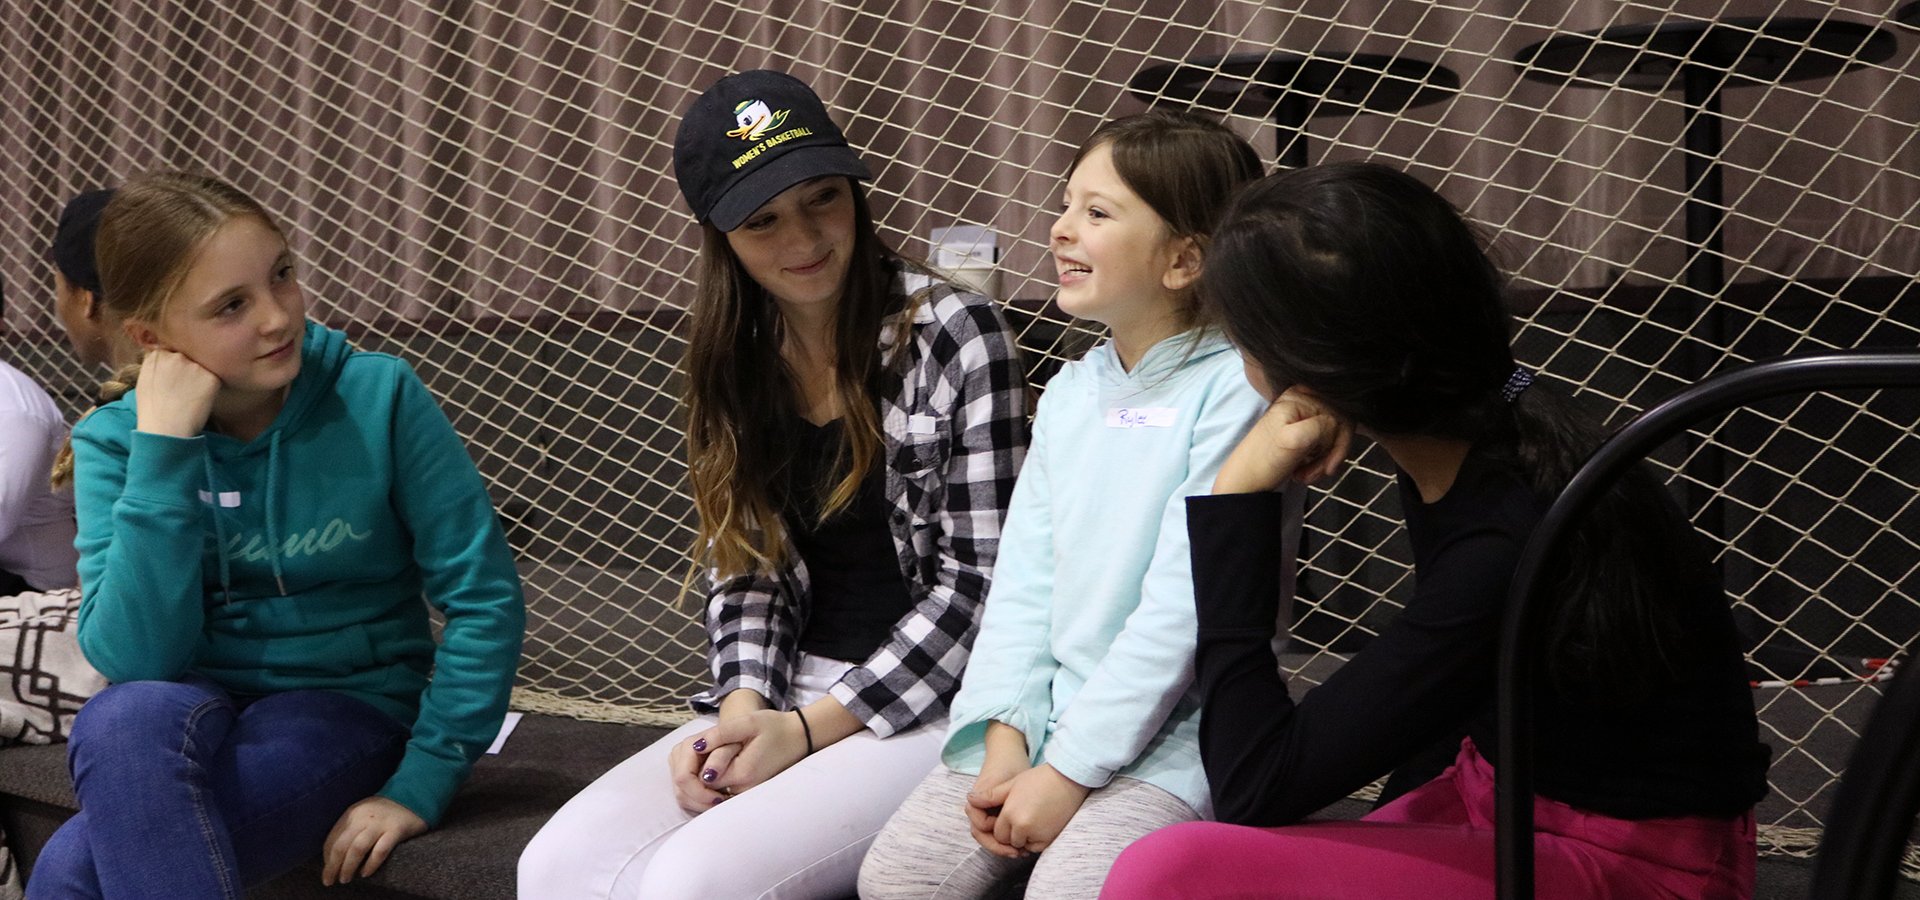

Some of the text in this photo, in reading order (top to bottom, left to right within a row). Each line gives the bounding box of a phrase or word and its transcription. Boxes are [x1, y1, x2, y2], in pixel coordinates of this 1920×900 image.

[732, 127, 814, 169] WOMEN'S BASKETBALL
[205, 517, 373, 562] uma
